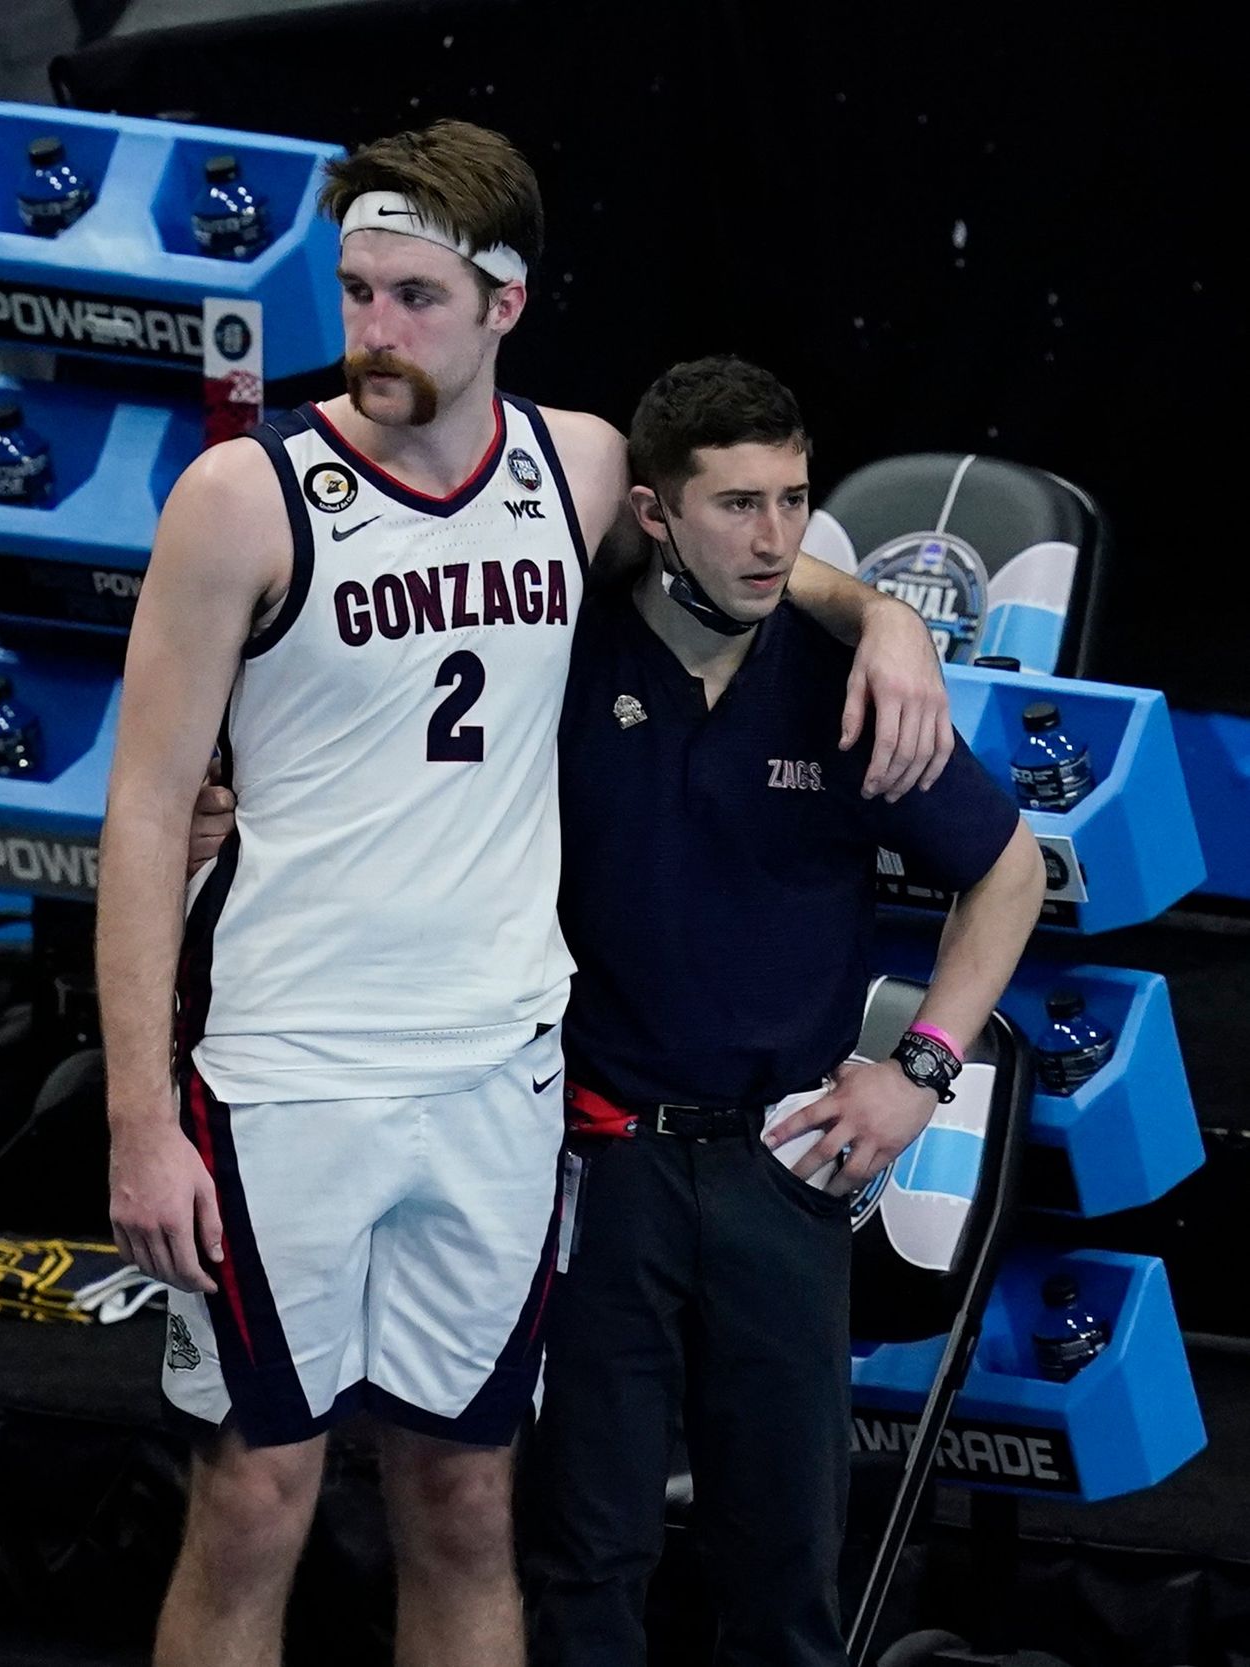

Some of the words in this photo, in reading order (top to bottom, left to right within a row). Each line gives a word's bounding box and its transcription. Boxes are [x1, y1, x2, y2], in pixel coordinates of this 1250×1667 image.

[333, 558, 569, 647] GONZAGA
[426, 649, 486, 762] 2
[767, 758, 824, 791] ZAGS
[850, 1417, 1060, 1481] WERADE
